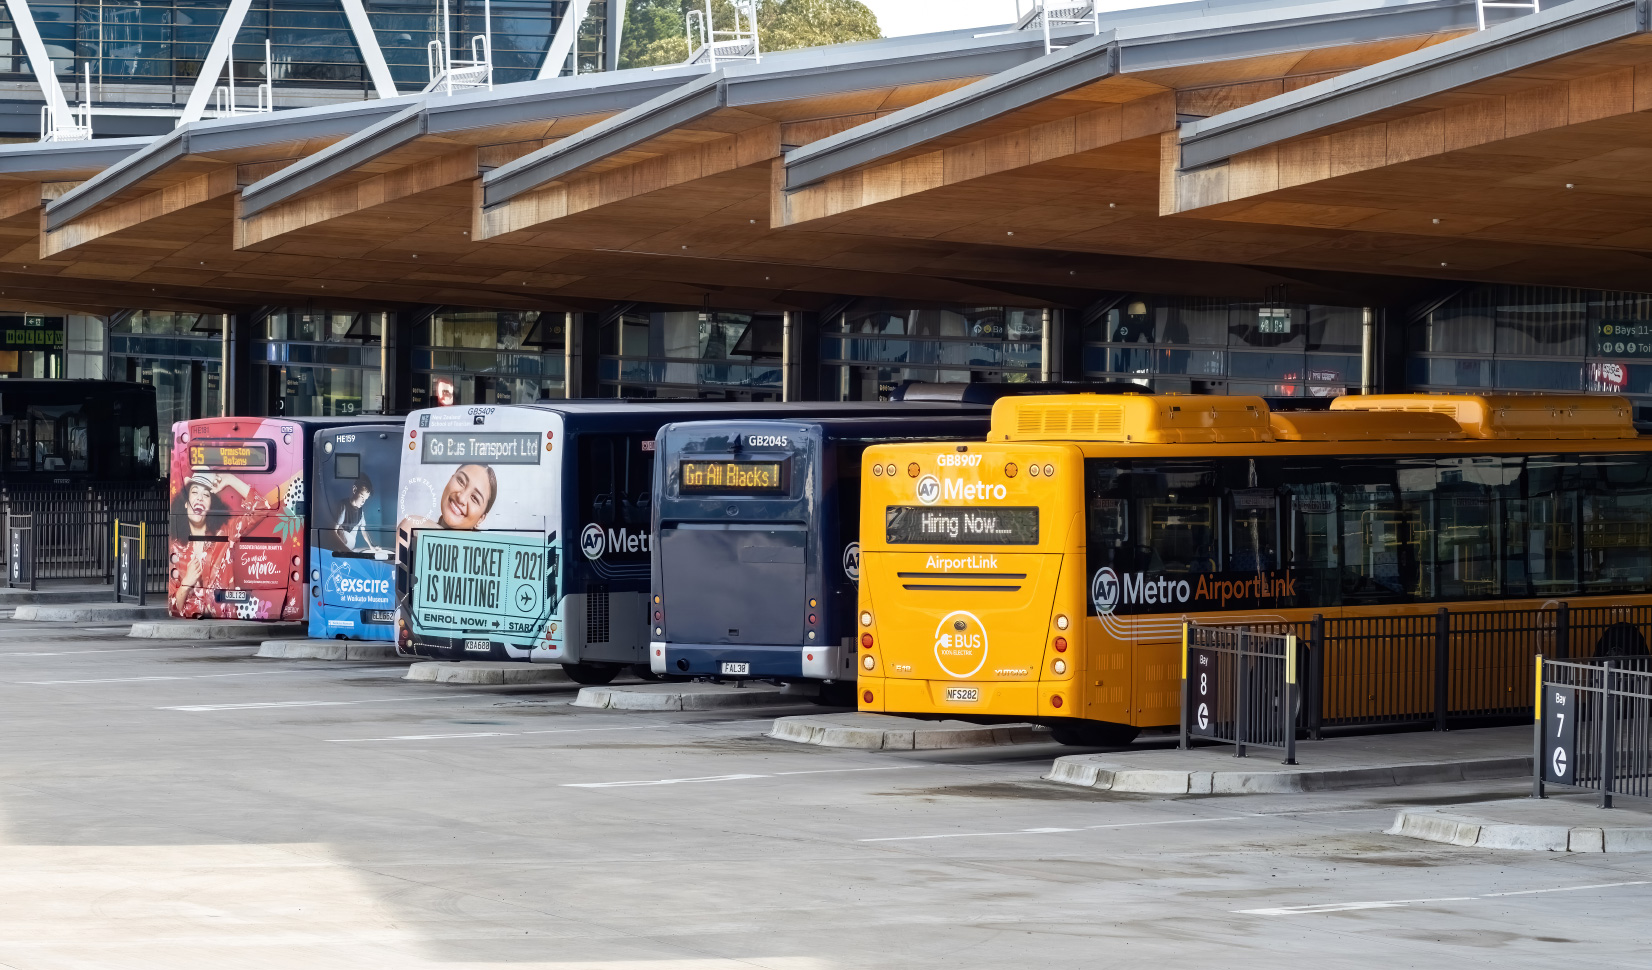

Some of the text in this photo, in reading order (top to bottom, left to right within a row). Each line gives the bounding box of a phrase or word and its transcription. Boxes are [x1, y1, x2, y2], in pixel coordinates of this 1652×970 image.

[1615, 326, 1636, 336] Bays
[342, 403, 354, 412] 19
[468, 408, 496, 416] GB5409
[336, 434, 356, 442] HE159
[748, 436, 788, 447] GB2045
[190, 446, 204, 464] 35
[430, 438, 444, 456] Go
[468, 438, 518, 460] Transport
[520, 438, 538, 456] Ltd
[224, 456, 247, 466] Botany
[937, 454, 982, 466] GB8907
[686, 464, 702, 486] Go
[706, 464, 722, 486] All
[726, 464, 769, 486] Blacks
[944, 478, 1007, 500] Metro
[922, 513, 958, 538] Hiring
[14, 544, 18, 557] 15
[241, 550, 267, 566] So much
[122, 552, 128, 568] 14
[428, 543, 504, 578] YOUR TICKET
[514, 550, 543, 582] 2021
[926, 555, 998, 572] AirportLink
[426, 574, 500, 608] IS WAITING!
[1124, 572, 1190, 605] Metro
[1194, 568, 1296, 607] AirportLink
[424, 614, 487, 627] ENROL NOW!
[508, 622, 534, 632] START
[955, 634, 980, 648] BUS
[1200, 655, 1208, 666] Bay
[1200, 673, 1207, 696] 8
[947, 689, 977, 700] NFS282
[1556, 692, 1566, 706] Bay
[1556, 713, 1564, 737] 7
